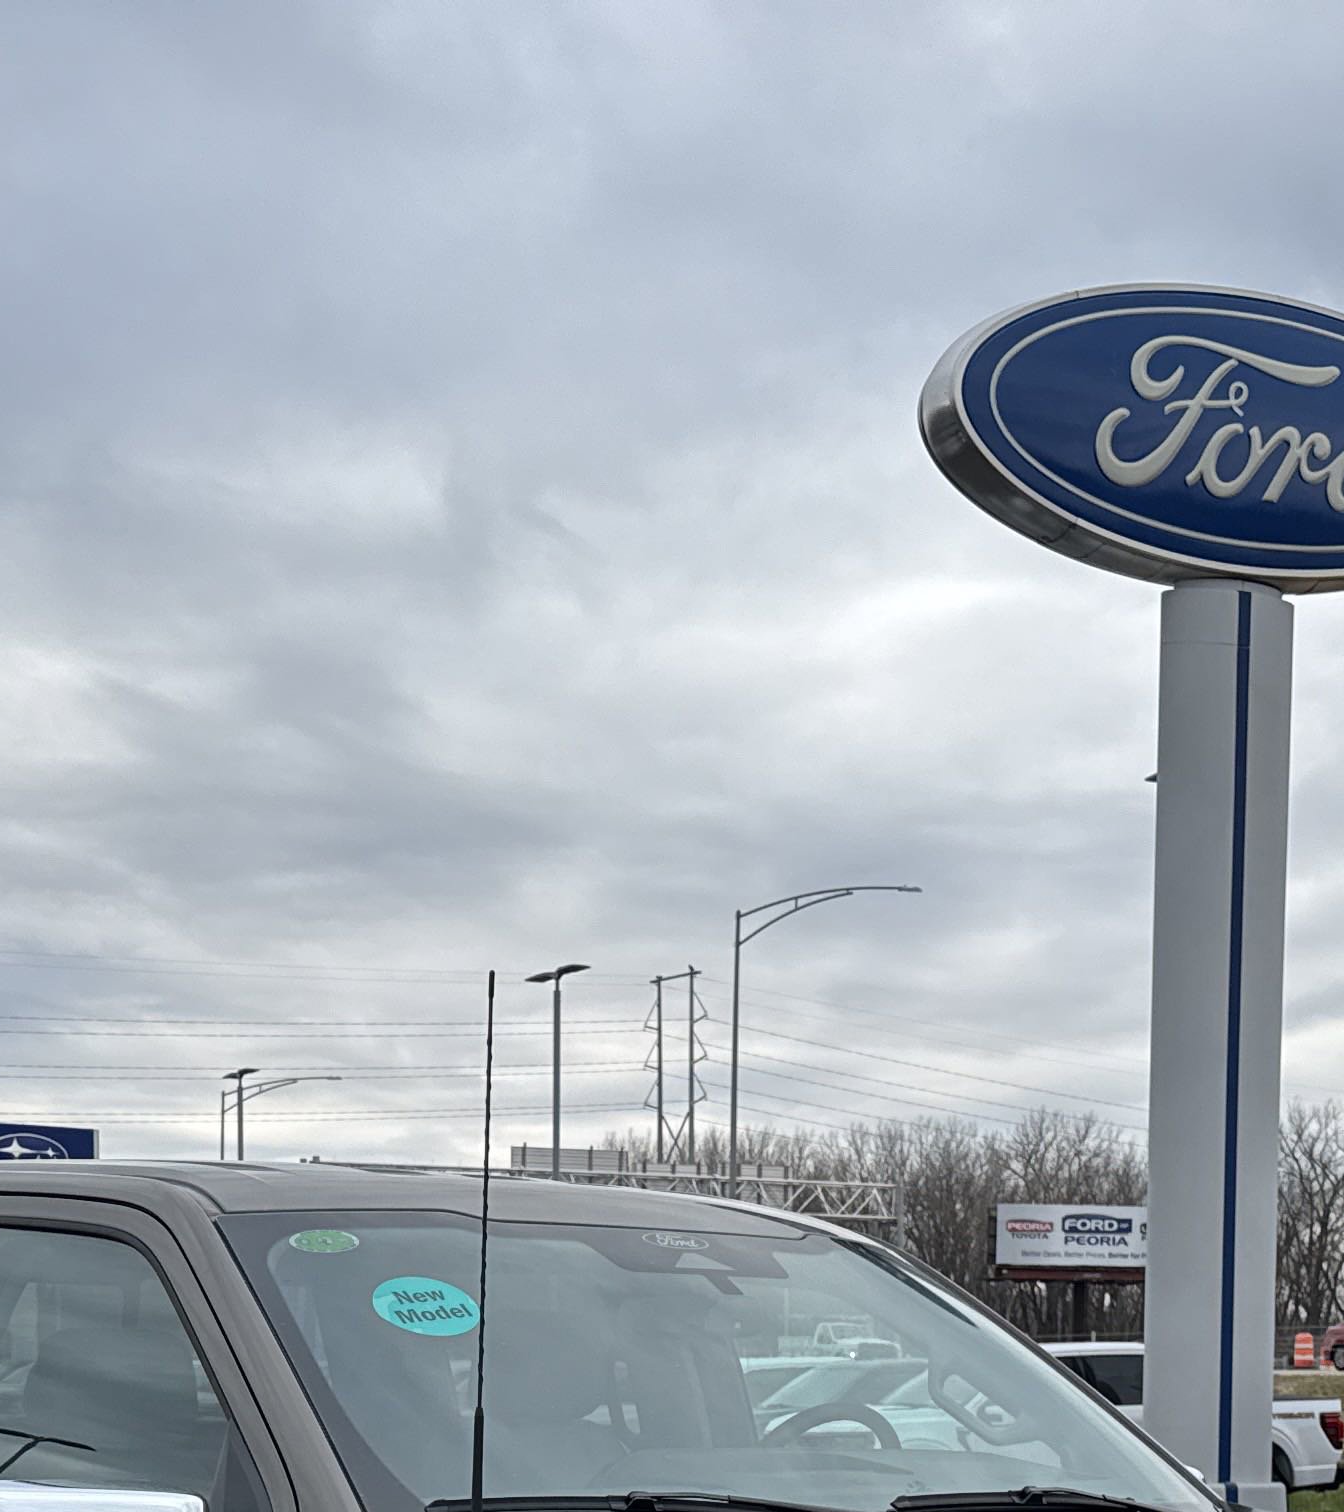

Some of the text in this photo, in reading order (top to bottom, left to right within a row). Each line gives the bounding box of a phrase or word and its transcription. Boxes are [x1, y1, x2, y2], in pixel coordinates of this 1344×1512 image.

[1007, 1221, 1052, 1232] PEORIA
[1064, 1218, 1118, 1232] FORD
[1011, 1232, 1049, 1240] TOYOTA
[1063, 1235, 1129, 1247] PEORIA
[392, 1288, 445, 1305] New
[394, 1304, 473, 1325] Model
